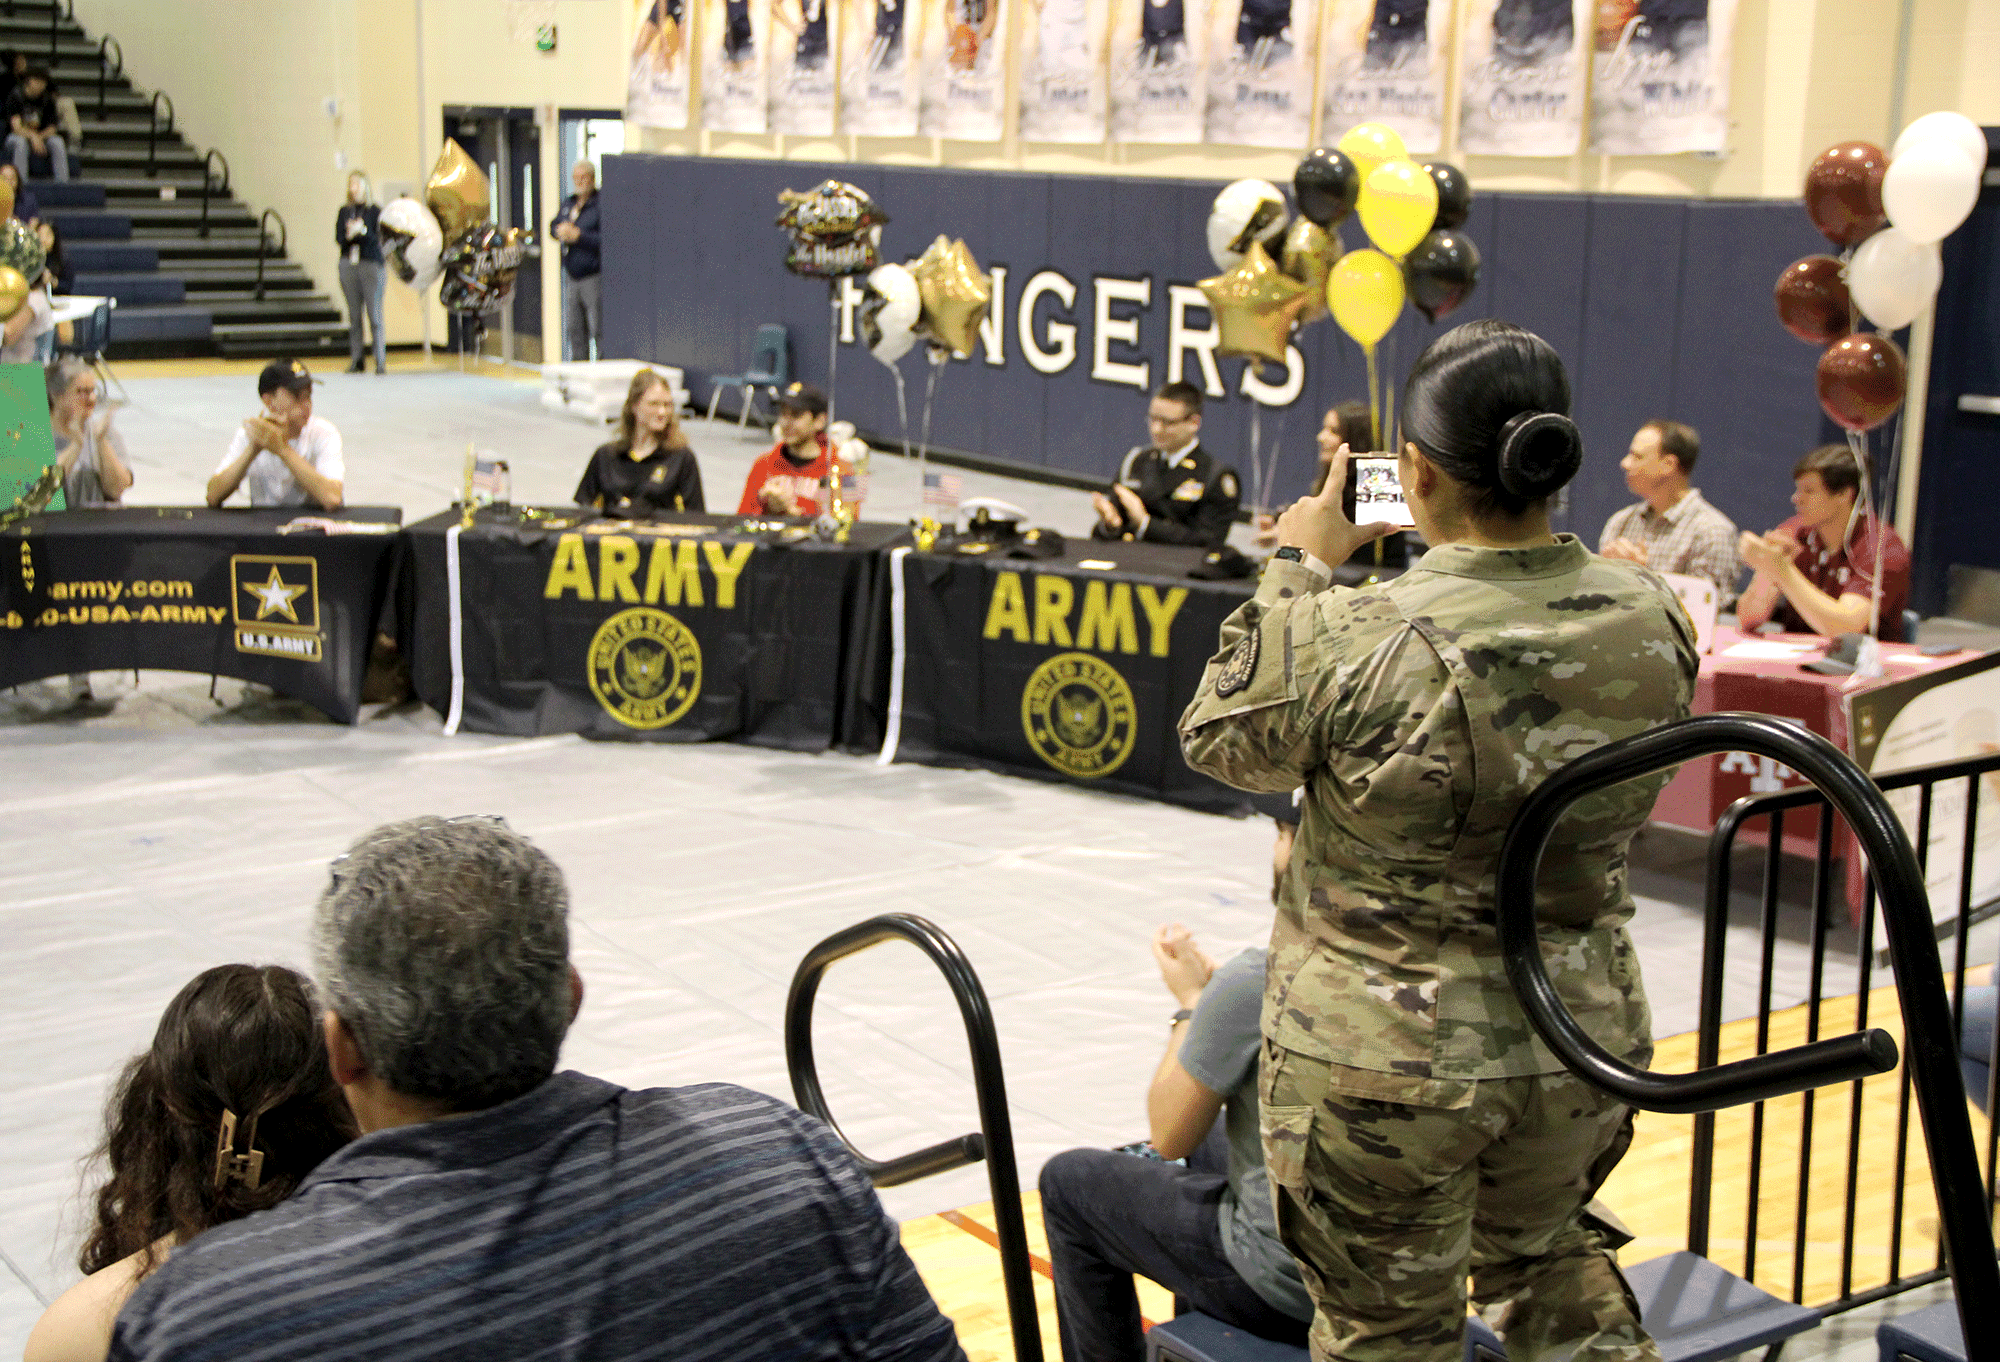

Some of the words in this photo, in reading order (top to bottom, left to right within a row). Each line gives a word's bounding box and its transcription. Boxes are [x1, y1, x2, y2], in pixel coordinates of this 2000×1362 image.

[838, 266, 1305, 407] NGERS
[48, 580, 194, 602] army.com
[544, 532, 756, 609] ARMY
[983, 570, 1190, 658] ARMY
